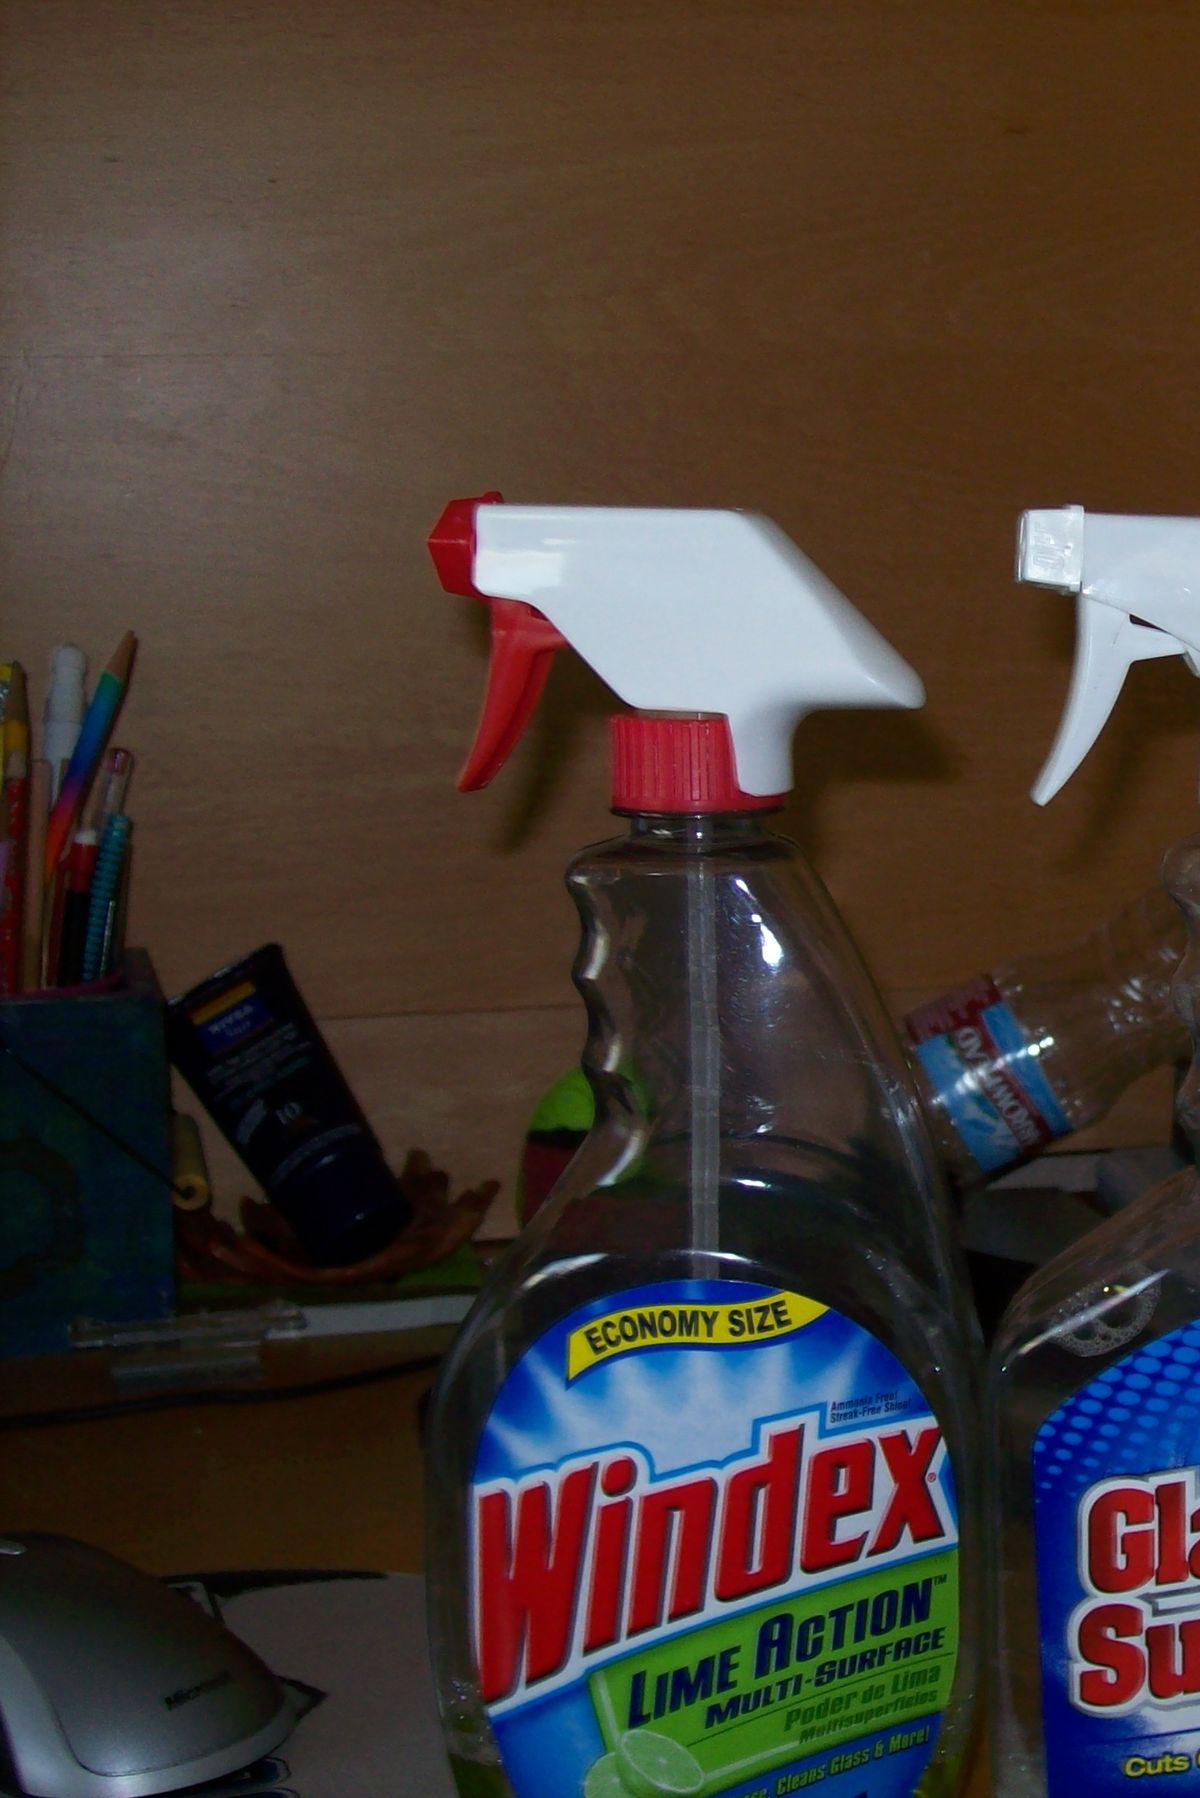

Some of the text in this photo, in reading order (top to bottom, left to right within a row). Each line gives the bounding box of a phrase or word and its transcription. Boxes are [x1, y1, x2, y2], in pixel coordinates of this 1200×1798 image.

[584, 1300, 792, 1355] ECONOMY SIZE
[830, 1404, 881, 1424] Streak-Free
[831, 1395, 873, 1412] Ammonia
[478, 1424, 945, 1703] Windex
[628, 1645, 742, 1729] LIME
[754, 1578, 933, 1680] ACTION
[704, 1627, 946, 1730] MULTI-SURFACE
[784, 1666, 940, 1731] Poder de Lima
[800, 1690, 937, 1744] Multisuperficies
[777, 1764, 825, 1795] Cleans
[830, 1746, 870, 1775] Glass
[889, 1726, 930, 1753] More!
[1123, 1755, 1190, 1778] Cuts
